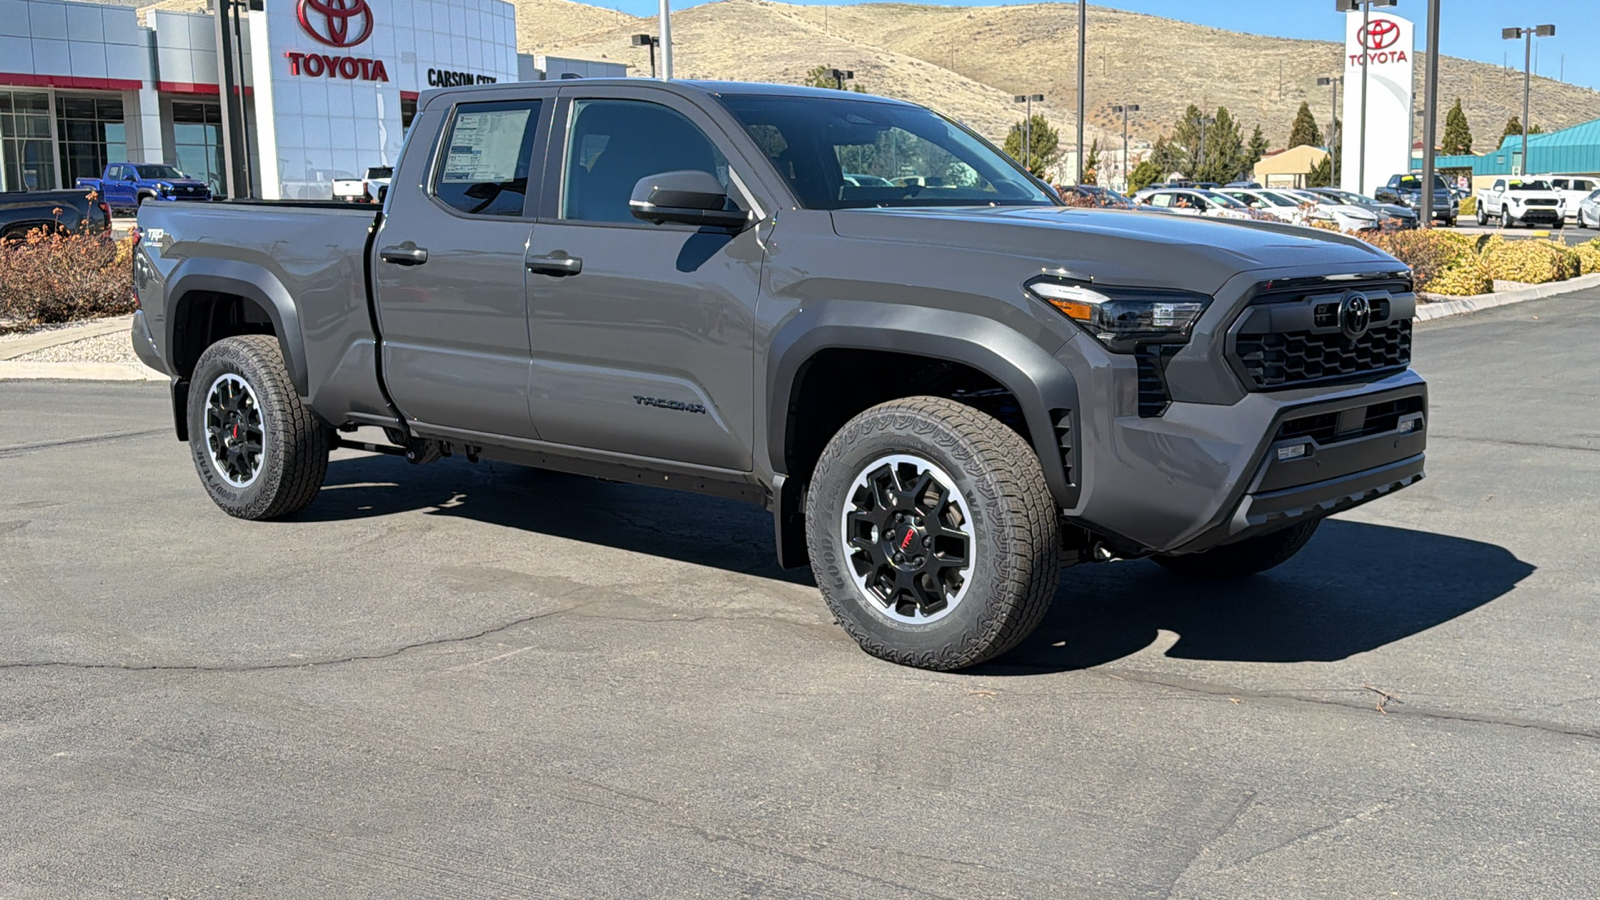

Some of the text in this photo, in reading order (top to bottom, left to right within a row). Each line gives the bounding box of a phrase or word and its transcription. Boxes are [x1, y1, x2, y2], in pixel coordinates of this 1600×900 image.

[286, 51, 389, 82] TOYOTA
[1349, 50, 1408, 67] TOYOTA
[428, 68, 474, 88] CARSON
[147, 228, 164, 241] TRD
[632, 395, 706, 414] TACOMA
[901, 528, 914, 548] TRD
